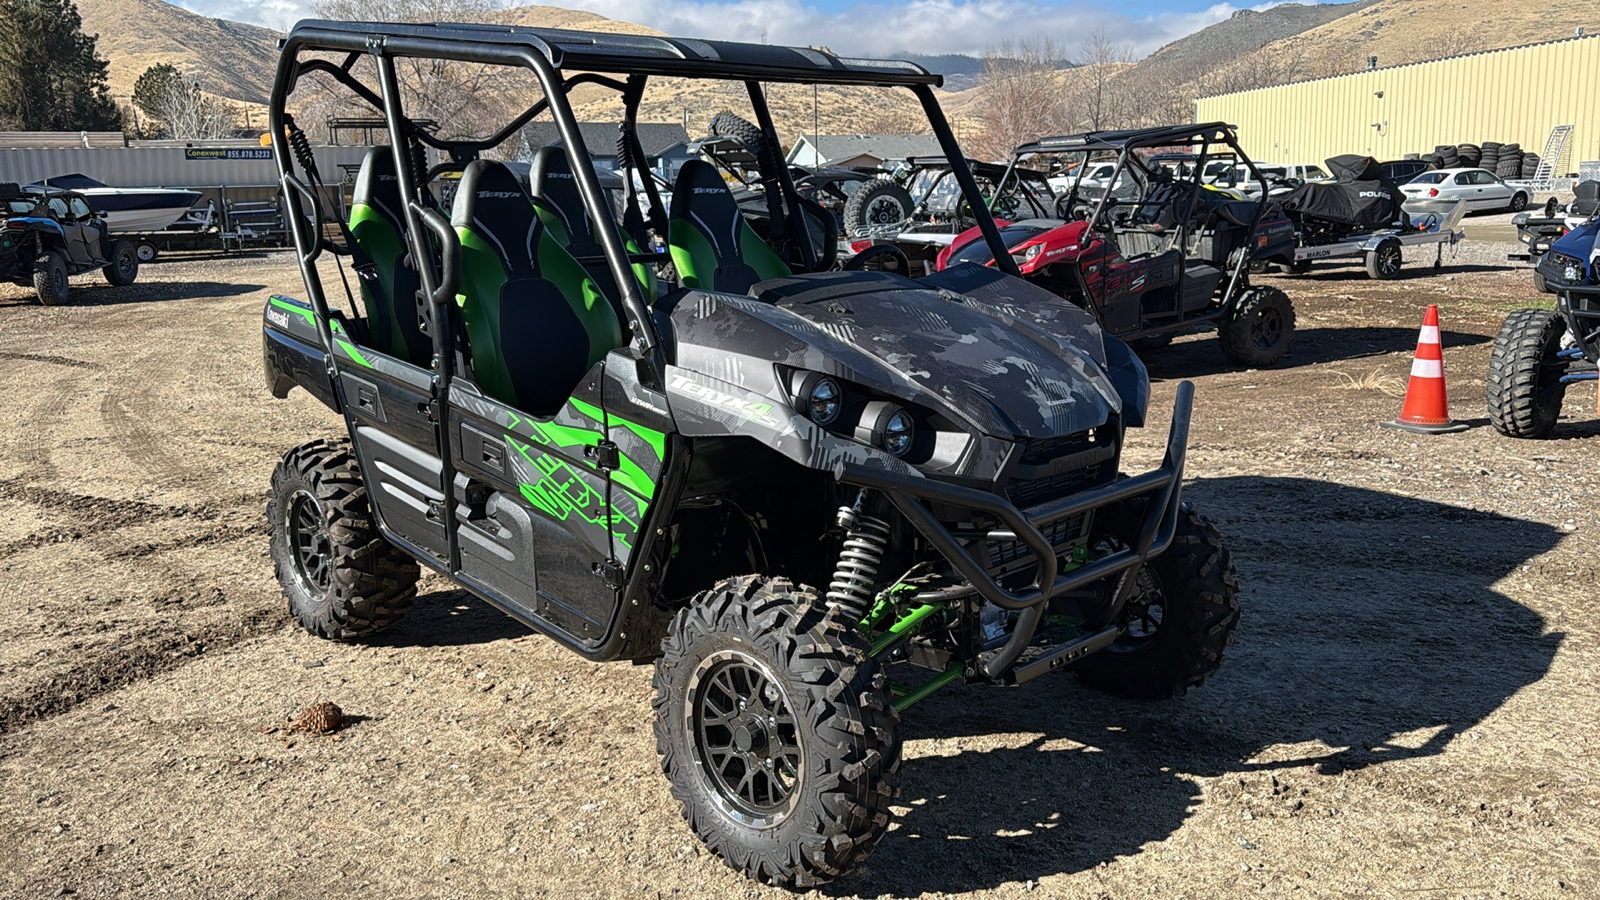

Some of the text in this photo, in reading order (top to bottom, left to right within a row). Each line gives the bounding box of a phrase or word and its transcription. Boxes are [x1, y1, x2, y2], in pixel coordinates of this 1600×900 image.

[187, 149, 270, 158] Conexwest 855.878.5233
[1359, 191, 1391, 200] POLARIS
[1306, 249, 1331, 258] MARLON
